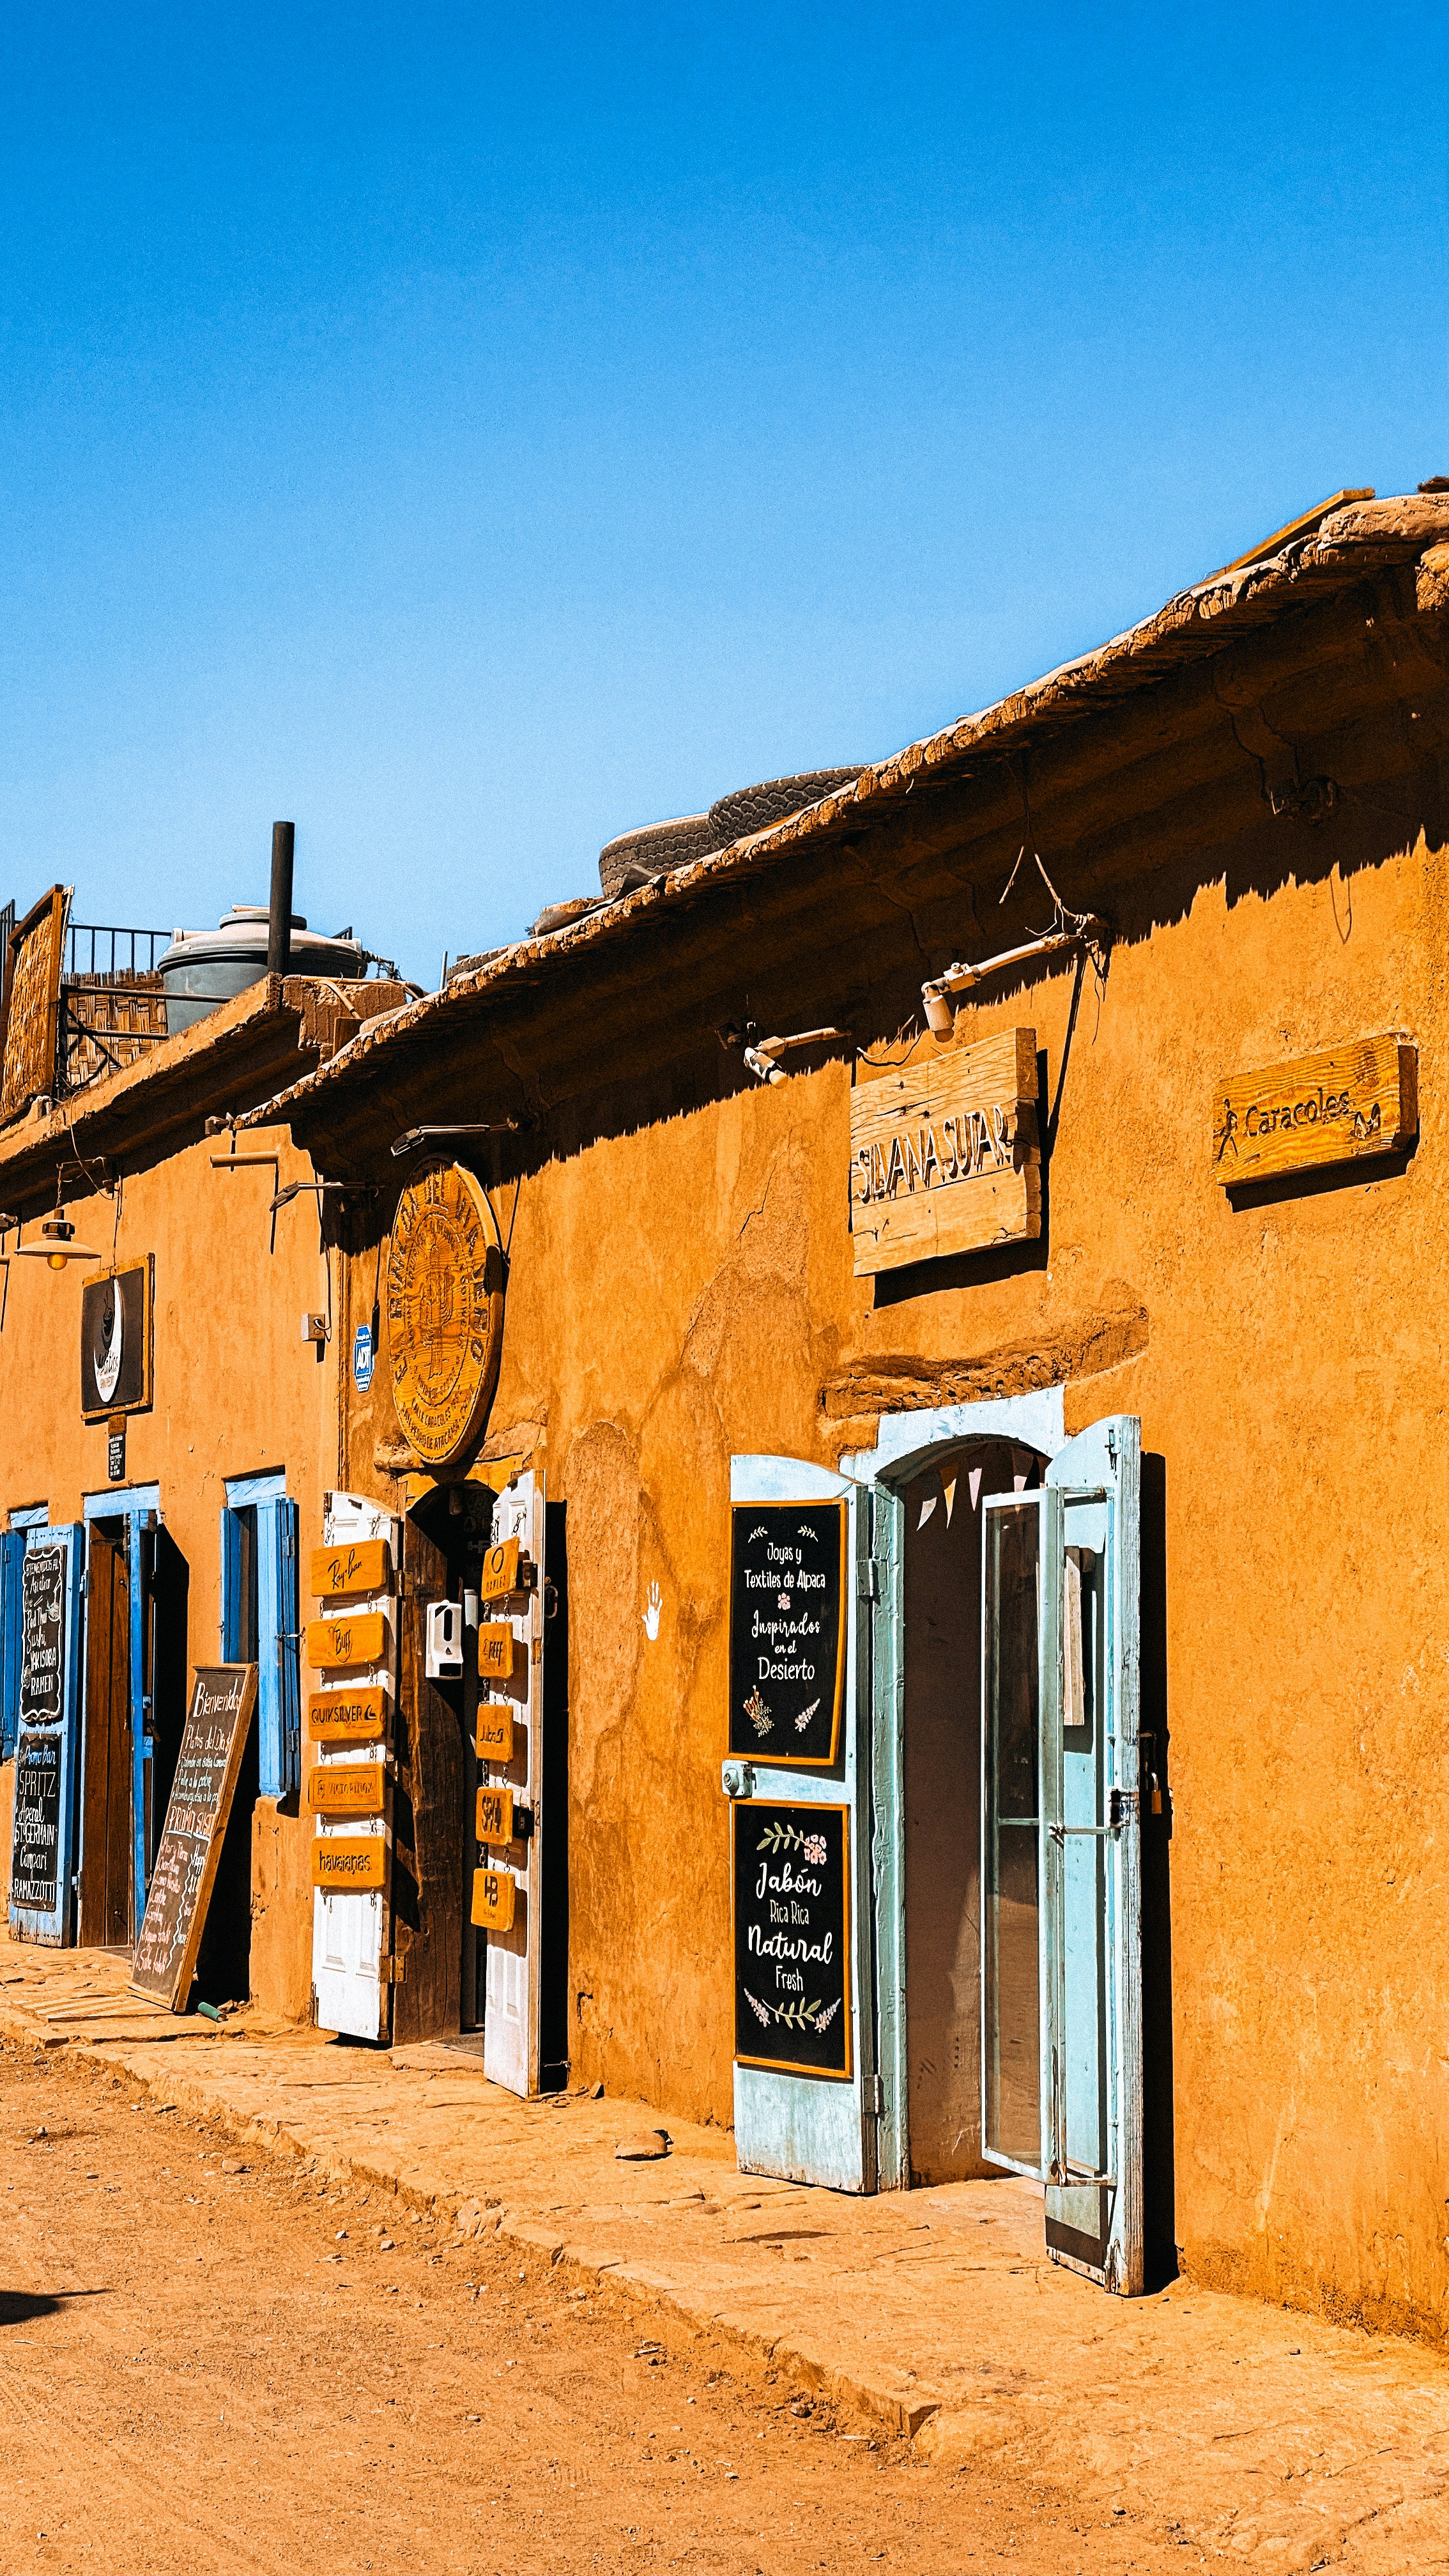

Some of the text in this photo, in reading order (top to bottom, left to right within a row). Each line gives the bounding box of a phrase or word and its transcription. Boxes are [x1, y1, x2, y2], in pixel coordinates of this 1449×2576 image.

[1246, 1087, 1349, 1137] Caracoles
[857, 1105, 1008, 1200] SILVANA SUTAR
[357, 1346, 371, 1369] ADT
[767, 1542, 802, 1565] Joyas y
[744, 1569, 825, 1591] Textiles de Alpaca
[26, 1626, 47, 1654] Sushi
[751, 1609, 820, 1646] Inspirados
[30, 1646, 56, 1672] YAKISOBA
[774, 1640, 797, 1654] en el
[758, 1657, 815, 1680] Desierto
[31, 1674, 54, 1696] RAMEN
[311, 1705, 362, 1724] QUIKSILVER
[185, 1724, 203, 1750] Platos
[205, 1726, 215, 1751] del
[42, 1744, 56, 1766] Bar
[19, 1770, 56, 1798] SPRITZ
[19, 1797, 45, 1823] Aperol
[20, 1846, 47, 1879] Campari
[14, 1878, 56, 1903] RAMAZZOTTI
[756, 1862, 822, 1899] Jabón
[769, 1899, 809, 1925] Rica Rica
[748, 1924, 833, 1965] Natural
[776, 1965, 804, 1991] Fresh
